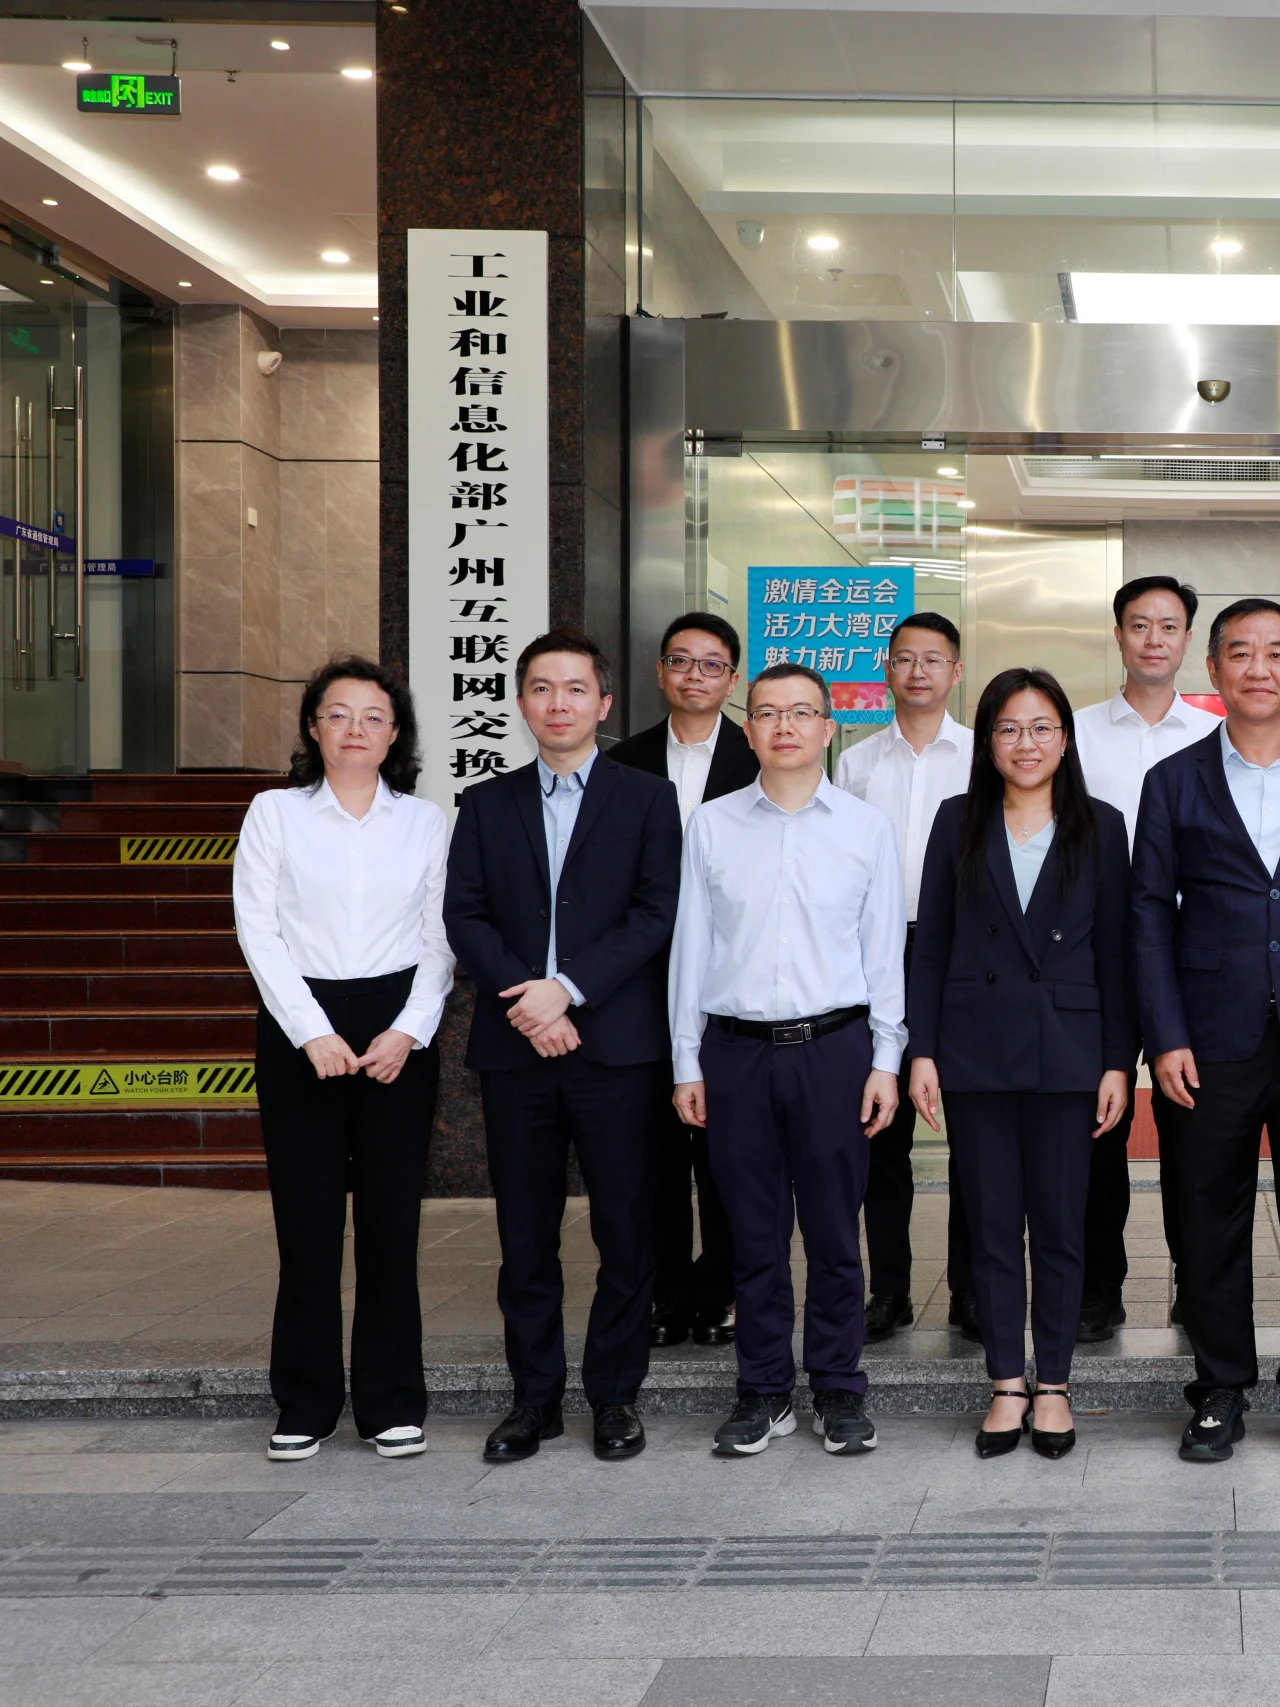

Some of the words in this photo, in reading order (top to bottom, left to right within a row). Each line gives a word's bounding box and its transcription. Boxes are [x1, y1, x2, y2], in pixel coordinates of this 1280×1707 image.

[145, 92, 173, 105] EXIT
[15, 525, 59, 548] 广东省通信管理局
[448, 252, 510, 807] 工业和信息化部广州互联网交换
[763, 578, 899, 604] 激情全运会
[763, 612, 899, 638] 活力大湾区
[124, 1070, 189, 1086] 小心台阶
